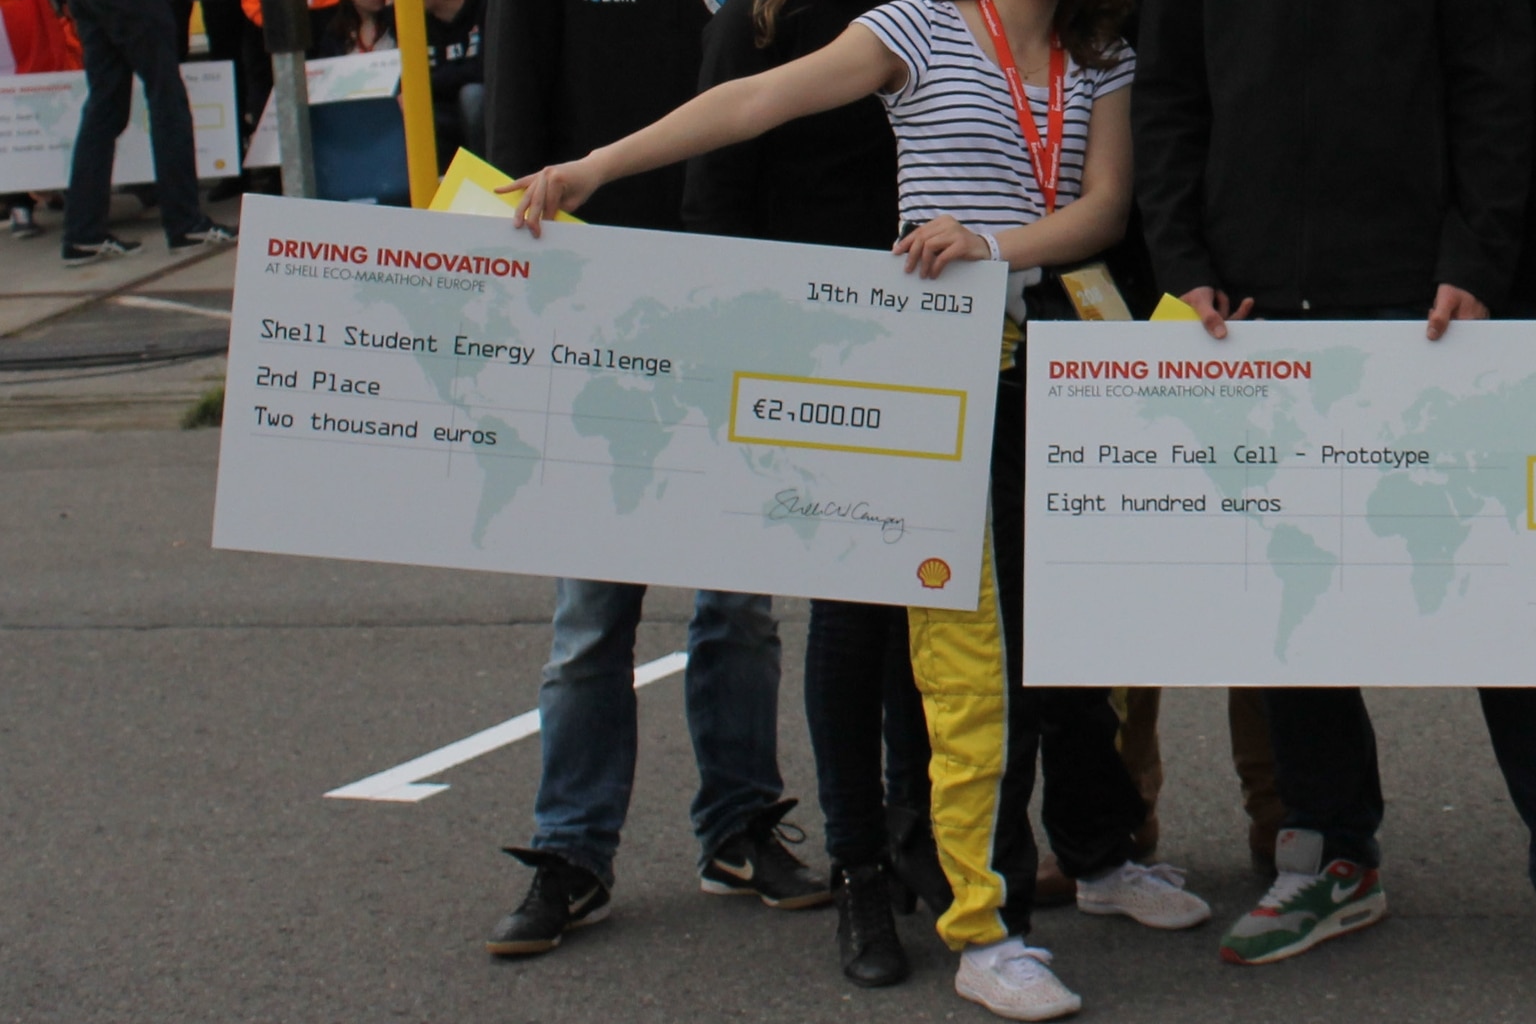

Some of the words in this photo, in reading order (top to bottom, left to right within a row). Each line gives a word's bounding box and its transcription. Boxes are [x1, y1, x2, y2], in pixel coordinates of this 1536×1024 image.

[267, 238, 368, 264] DRIVING
[377, 248, 530, 279] INNOVATION
[265, 262, 281, 274] AT
[284, 264, 318, 278] SHELL
[323, 266, 432, 288] ECO-MARATHON
[437, 278, 485, 293] EUROPE
[806, 282, 859, 304] 19th
[870, 288, 909, 312] May
[921, 292, 974, 314] 2013
[260, 319, 327, 344] Shell
[344, 326, 438, 353] Student
[454, 336, 535, 365] Energy
[551, 344, 672, 377] Challenge
[256, 366, 298, 389] 2nd
[312, 371, 381, 396] Place
[1048, 360, 1149, 380] DRIVING
[1158, 360, 1312, 380] INNOVATION
[1048, 385, 1063, 397] AT
[1067, 385, 1101, 397] SHELL
[1106, 385, 1216, 397] ECO-MARATHON
[1220, 385, 1269, 398] EUROPE
[254, 406, 294, 429] Two
[311, 412, 418, 439] thousand
[433, 426, 498, 446] euros
[1047, 445, 1084, 464] 2nd
[1098, 445, 1157, 464] Place
[1172, 445, 1217, 464] Fuel
[1233, 445, 1278, 464] Cell
[1321, 445, 1430, 469] Prototype
[1047, 493, 1106, 517] Eight
[1121, 493, 1207, 512] hundred
[1221, 497, 1282, 512] euros
